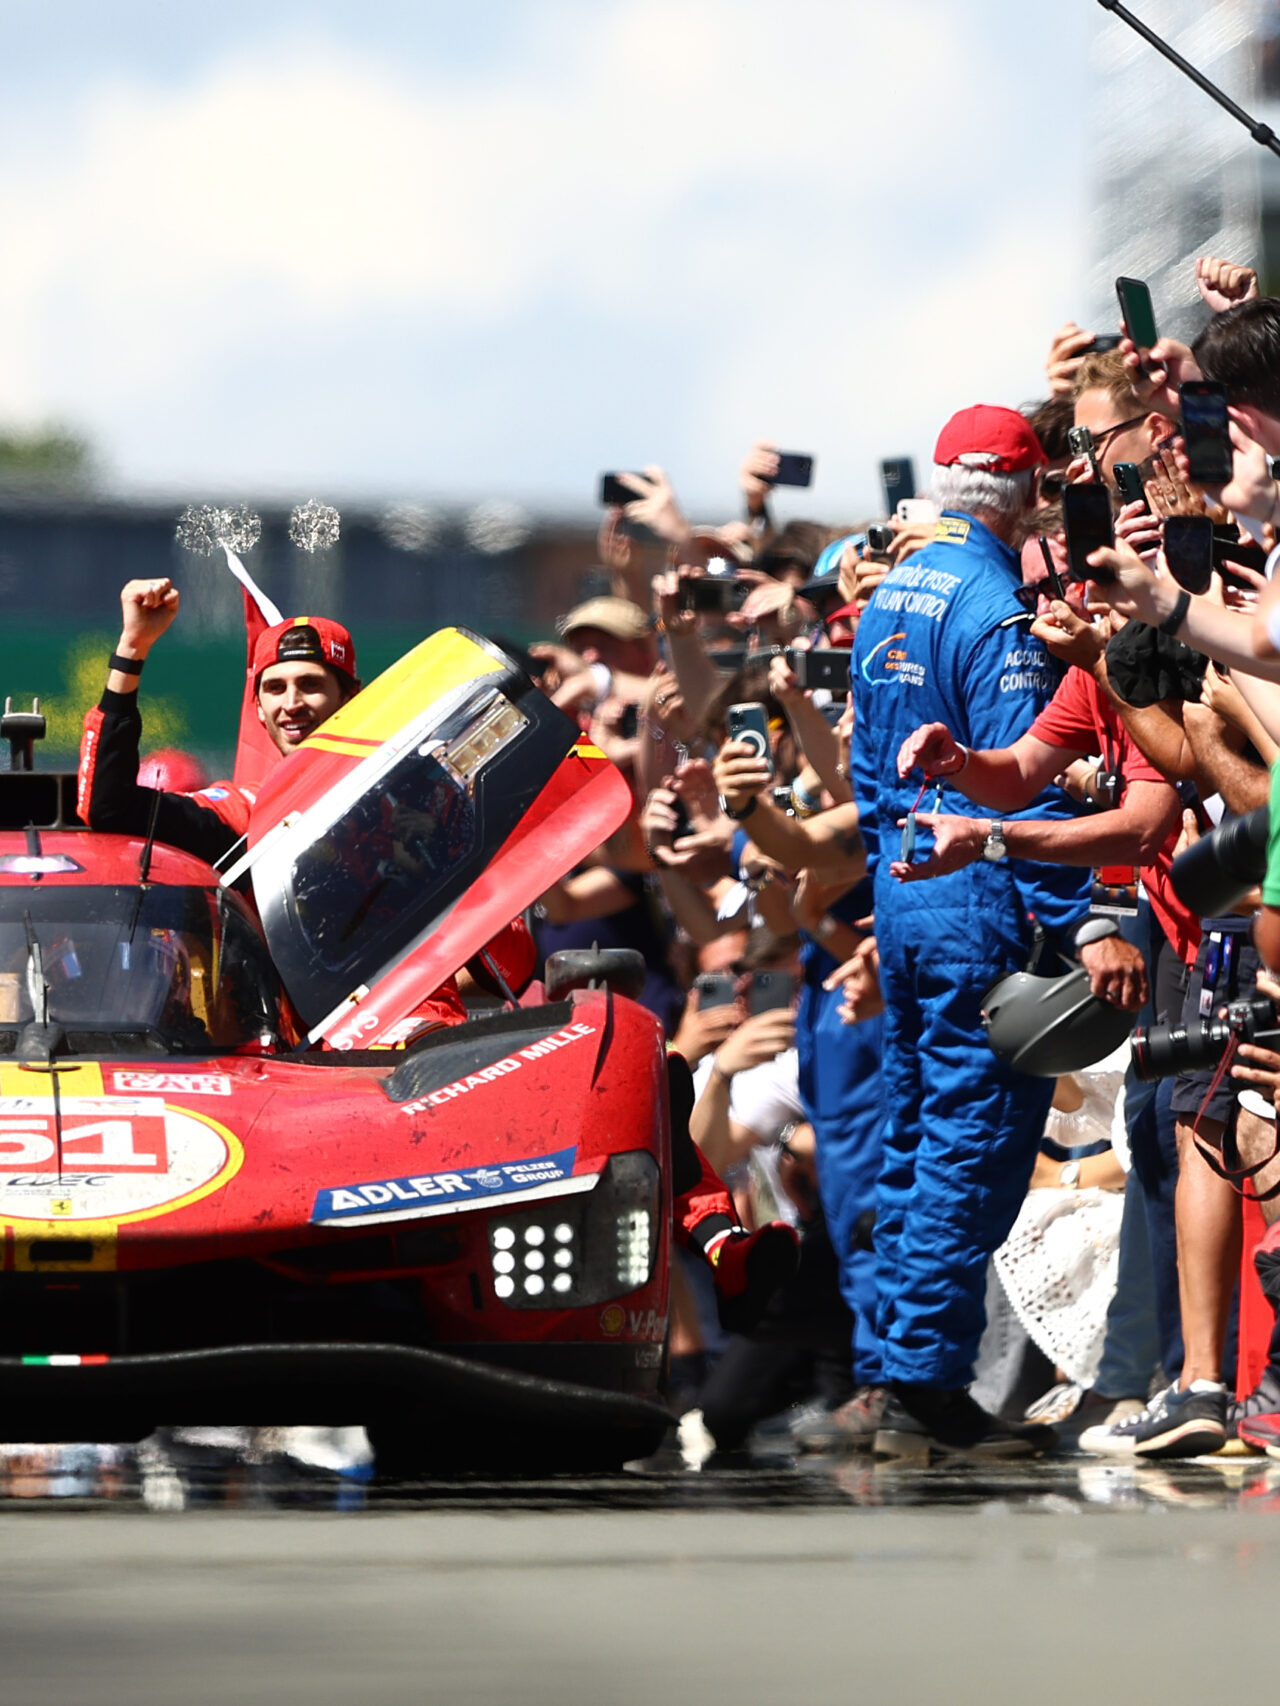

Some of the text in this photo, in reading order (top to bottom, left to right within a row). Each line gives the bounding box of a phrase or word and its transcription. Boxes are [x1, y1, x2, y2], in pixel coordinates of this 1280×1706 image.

[920, 568, 962, 596] PISTE
[401, 1022, 597, 1115] RICHARD MILLE
[122, 1080, 223, 1093] CAR
[504, 1161, 556, 1175] PELZER
[511, 1169, 564, 1184] GROUP
[329, 1173, 473, 1211] ADLER
